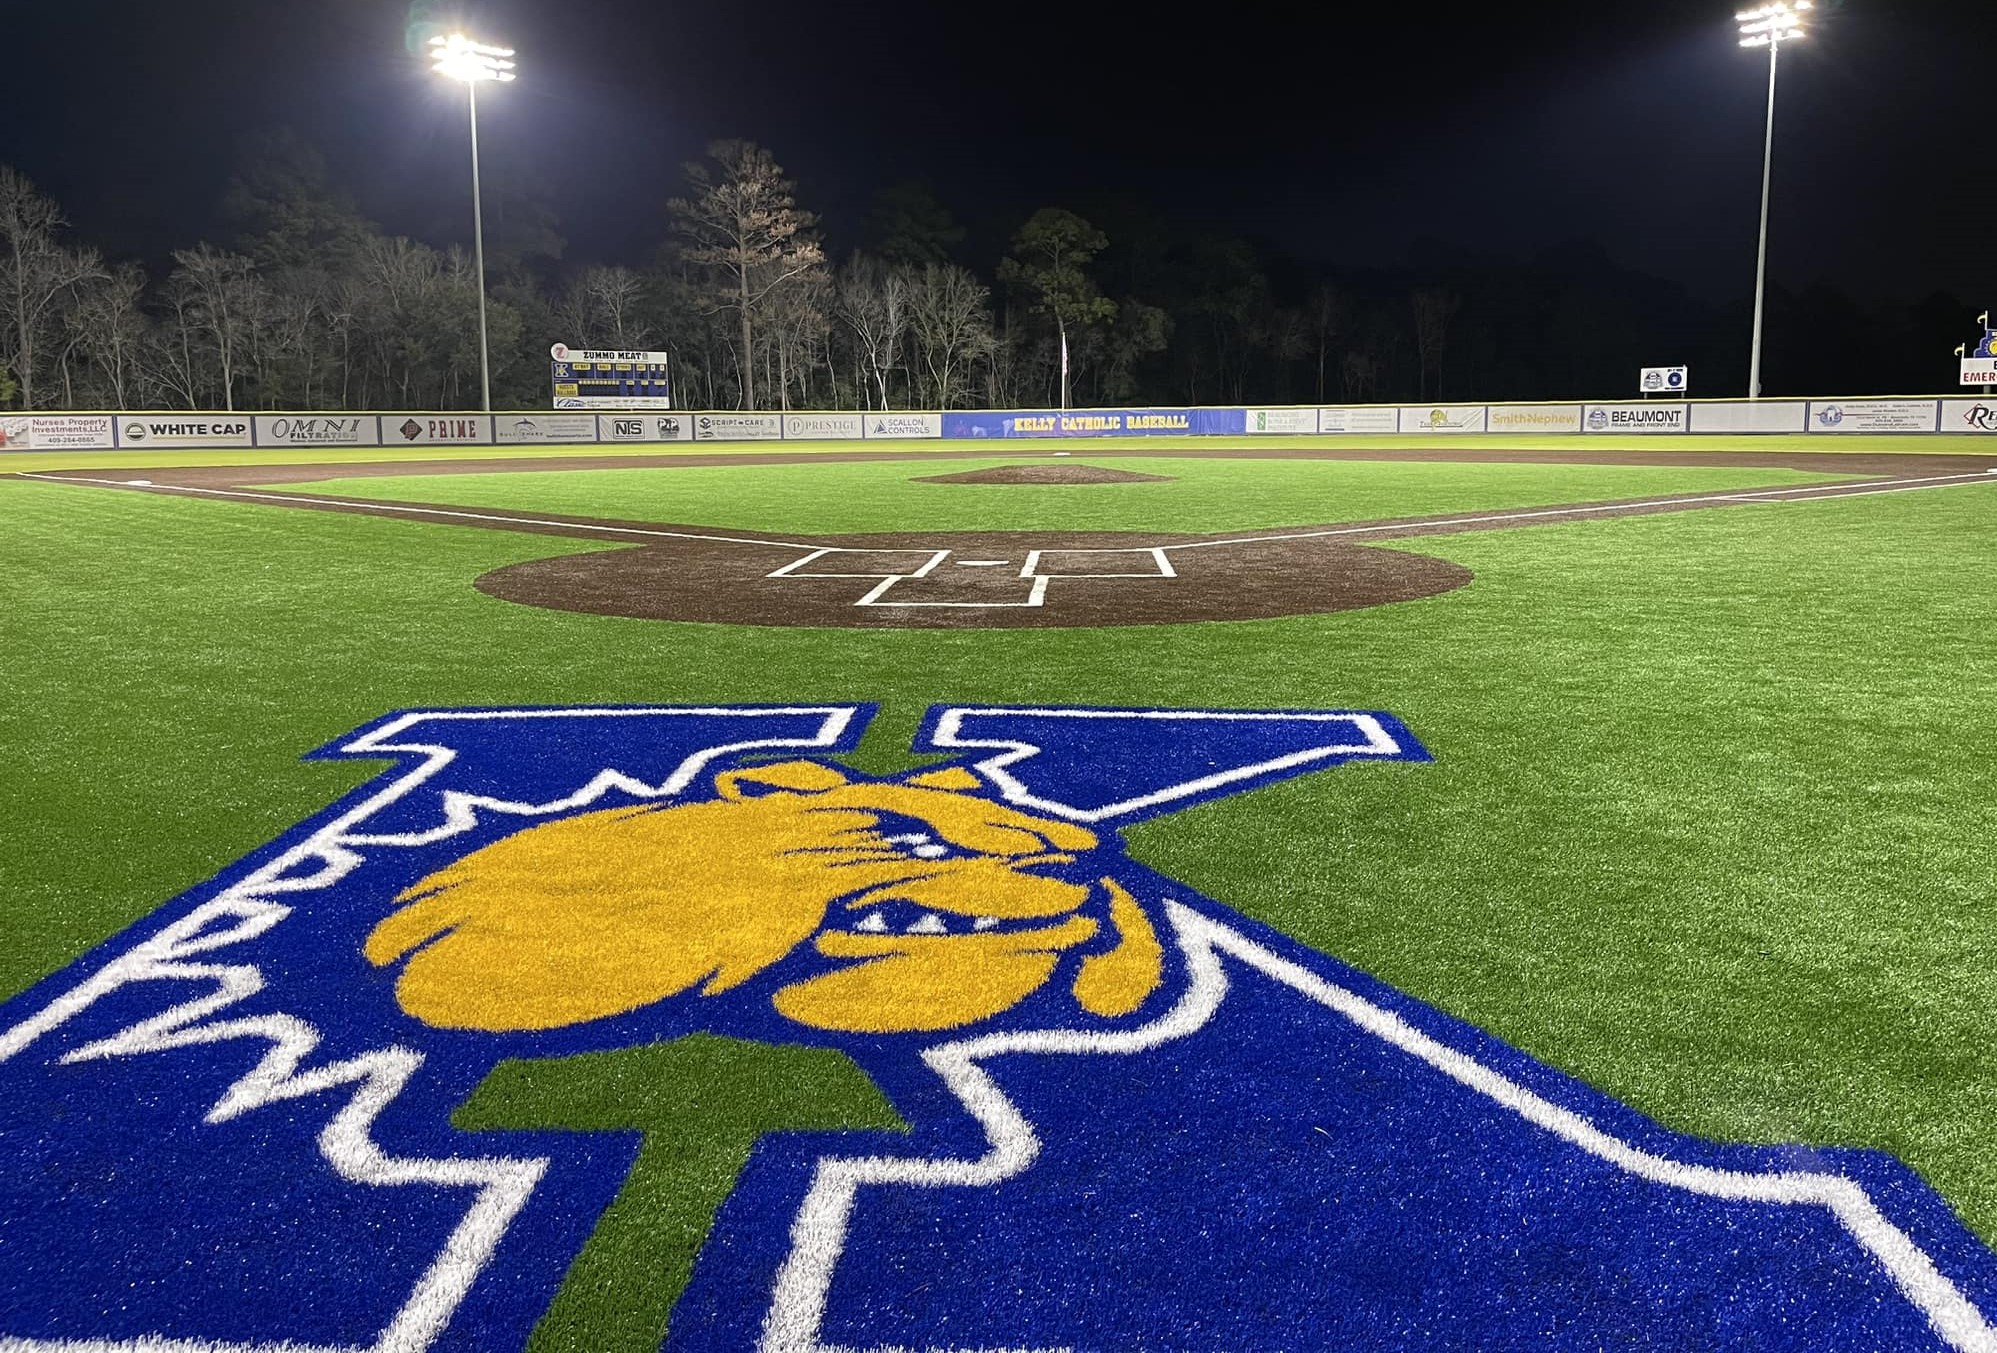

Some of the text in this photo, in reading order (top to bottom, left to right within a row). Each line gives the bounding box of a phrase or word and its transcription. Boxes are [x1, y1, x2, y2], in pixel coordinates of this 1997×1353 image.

[1963, 372, 1997, 382] EMER
[1611, 411, 1681, 422] BEAUMONT
[32, 418, 107, 428] Nurses Property
[805, 420, 855, 430] PRESTIGE
[888, 418, 924, 426] SCALLON
[1014, 415, 1189, 431] KELLY CATHOLIC BASEBALL
[149, 424, 246, 435] WHITE CAP
[272, 418, 360, 438] OMNI
[428, 420, 476, 438] PRIME
[888, 426, 930, 434] CONTROLS
